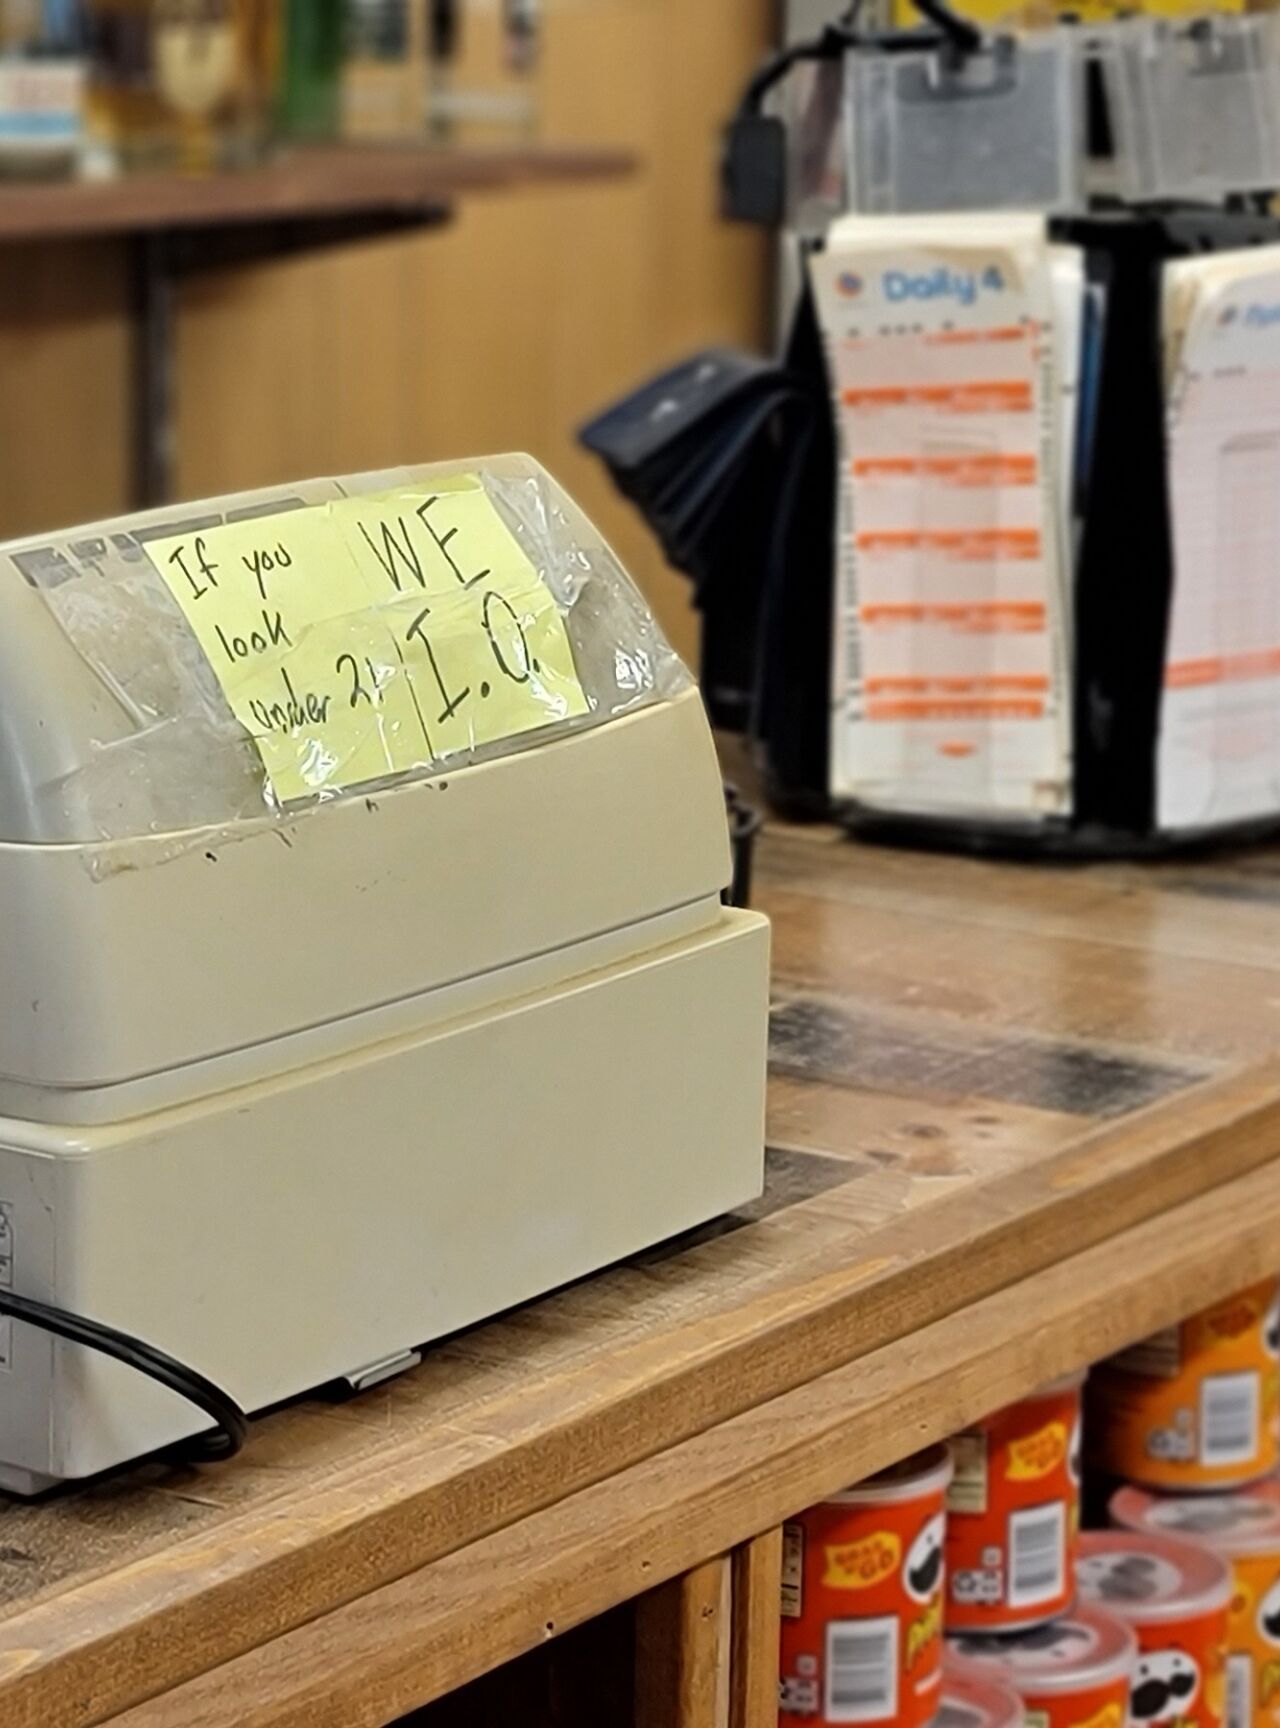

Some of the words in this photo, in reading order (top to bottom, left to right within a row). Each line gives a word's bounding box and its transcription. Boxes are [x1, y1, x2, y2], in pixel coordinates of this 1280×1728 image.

[881, 268, 977, 306] Daily
[981, 265, 1006, 291] 4
[168, 536, 221, 601] If
[241, 541, 293, 600] you
[356, 495, 491, 592] WE
[215, 610, 294, 664] look
[336, 654, 384, 709] 21
